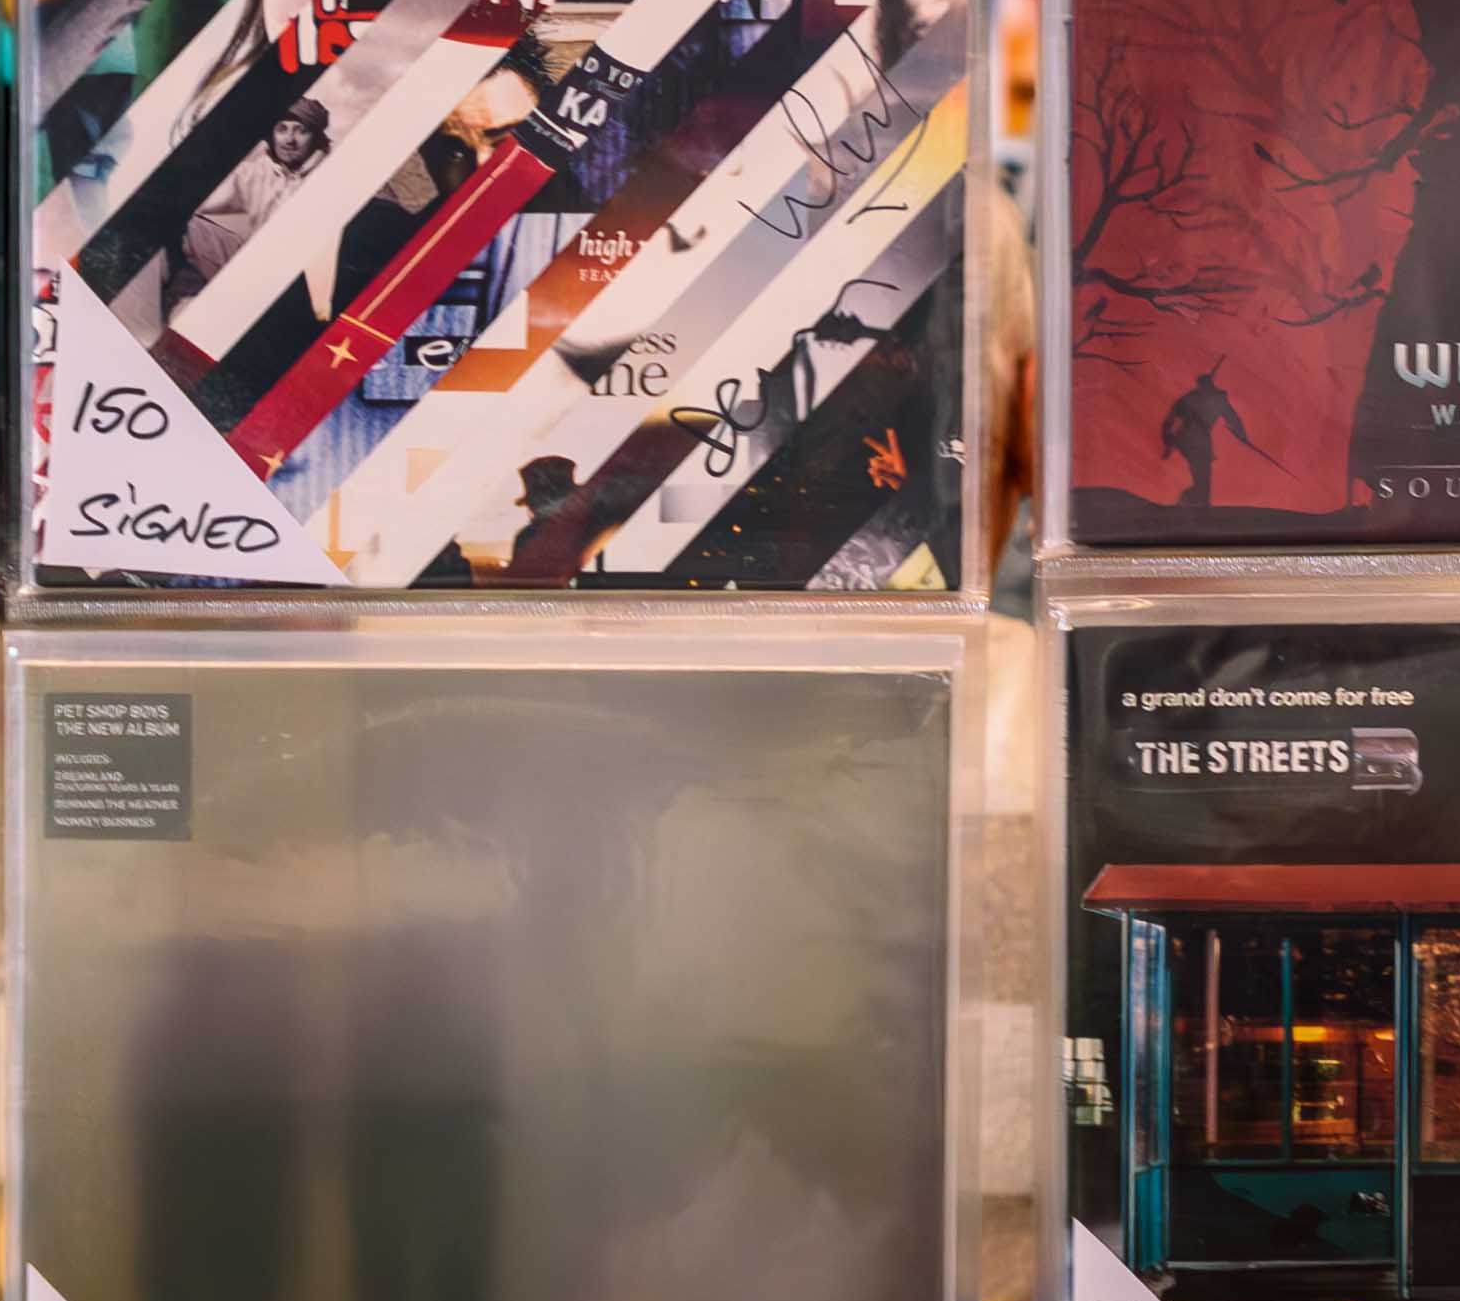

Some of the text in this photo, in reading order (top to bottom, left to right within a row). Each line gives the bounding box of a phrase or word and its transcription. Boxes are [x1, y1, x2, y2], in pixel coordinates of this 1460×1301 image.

[72, 382, 171, 443] 150
[54, 703, 84, 718] PET
[86, 704, 128, 718] SHOP
[1121, 686, 1415, 712] a grand don't come for free
[55, 720, 181, 736] THE NEW ALBUM
[1135, 740, 1350, 774] THE STREETS
